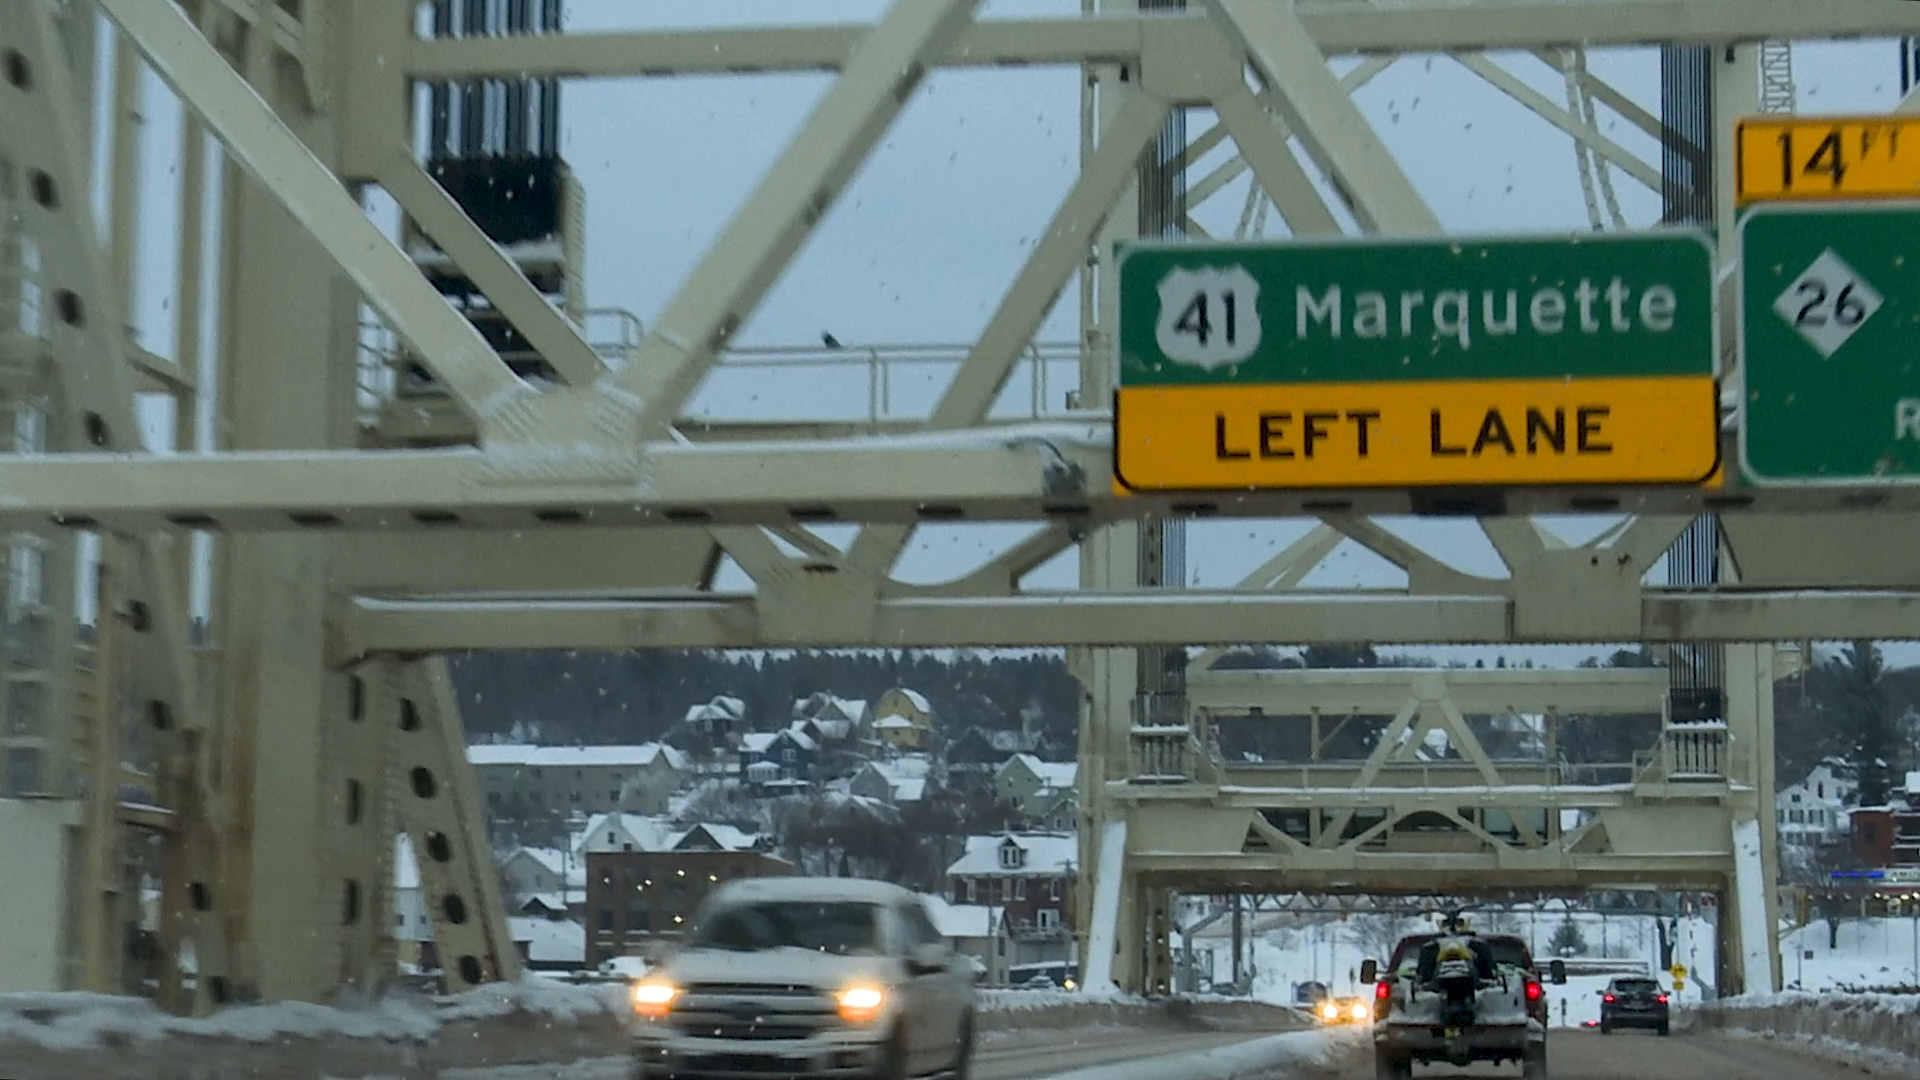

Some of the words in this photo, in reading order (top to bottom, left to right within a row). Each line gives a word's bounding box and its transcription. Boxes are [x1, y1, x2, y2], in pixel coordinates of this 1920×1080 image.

[1776, 130, 1849, 188] 14
[1173, 289, 1238, 347] 41
[1294, 276, 1678, 351] Marquette
[1793, 276, 1867, 328] 26
[1215, 409, 1381, 461] LEFT
[1430, 405, 1615, 458] LANE
